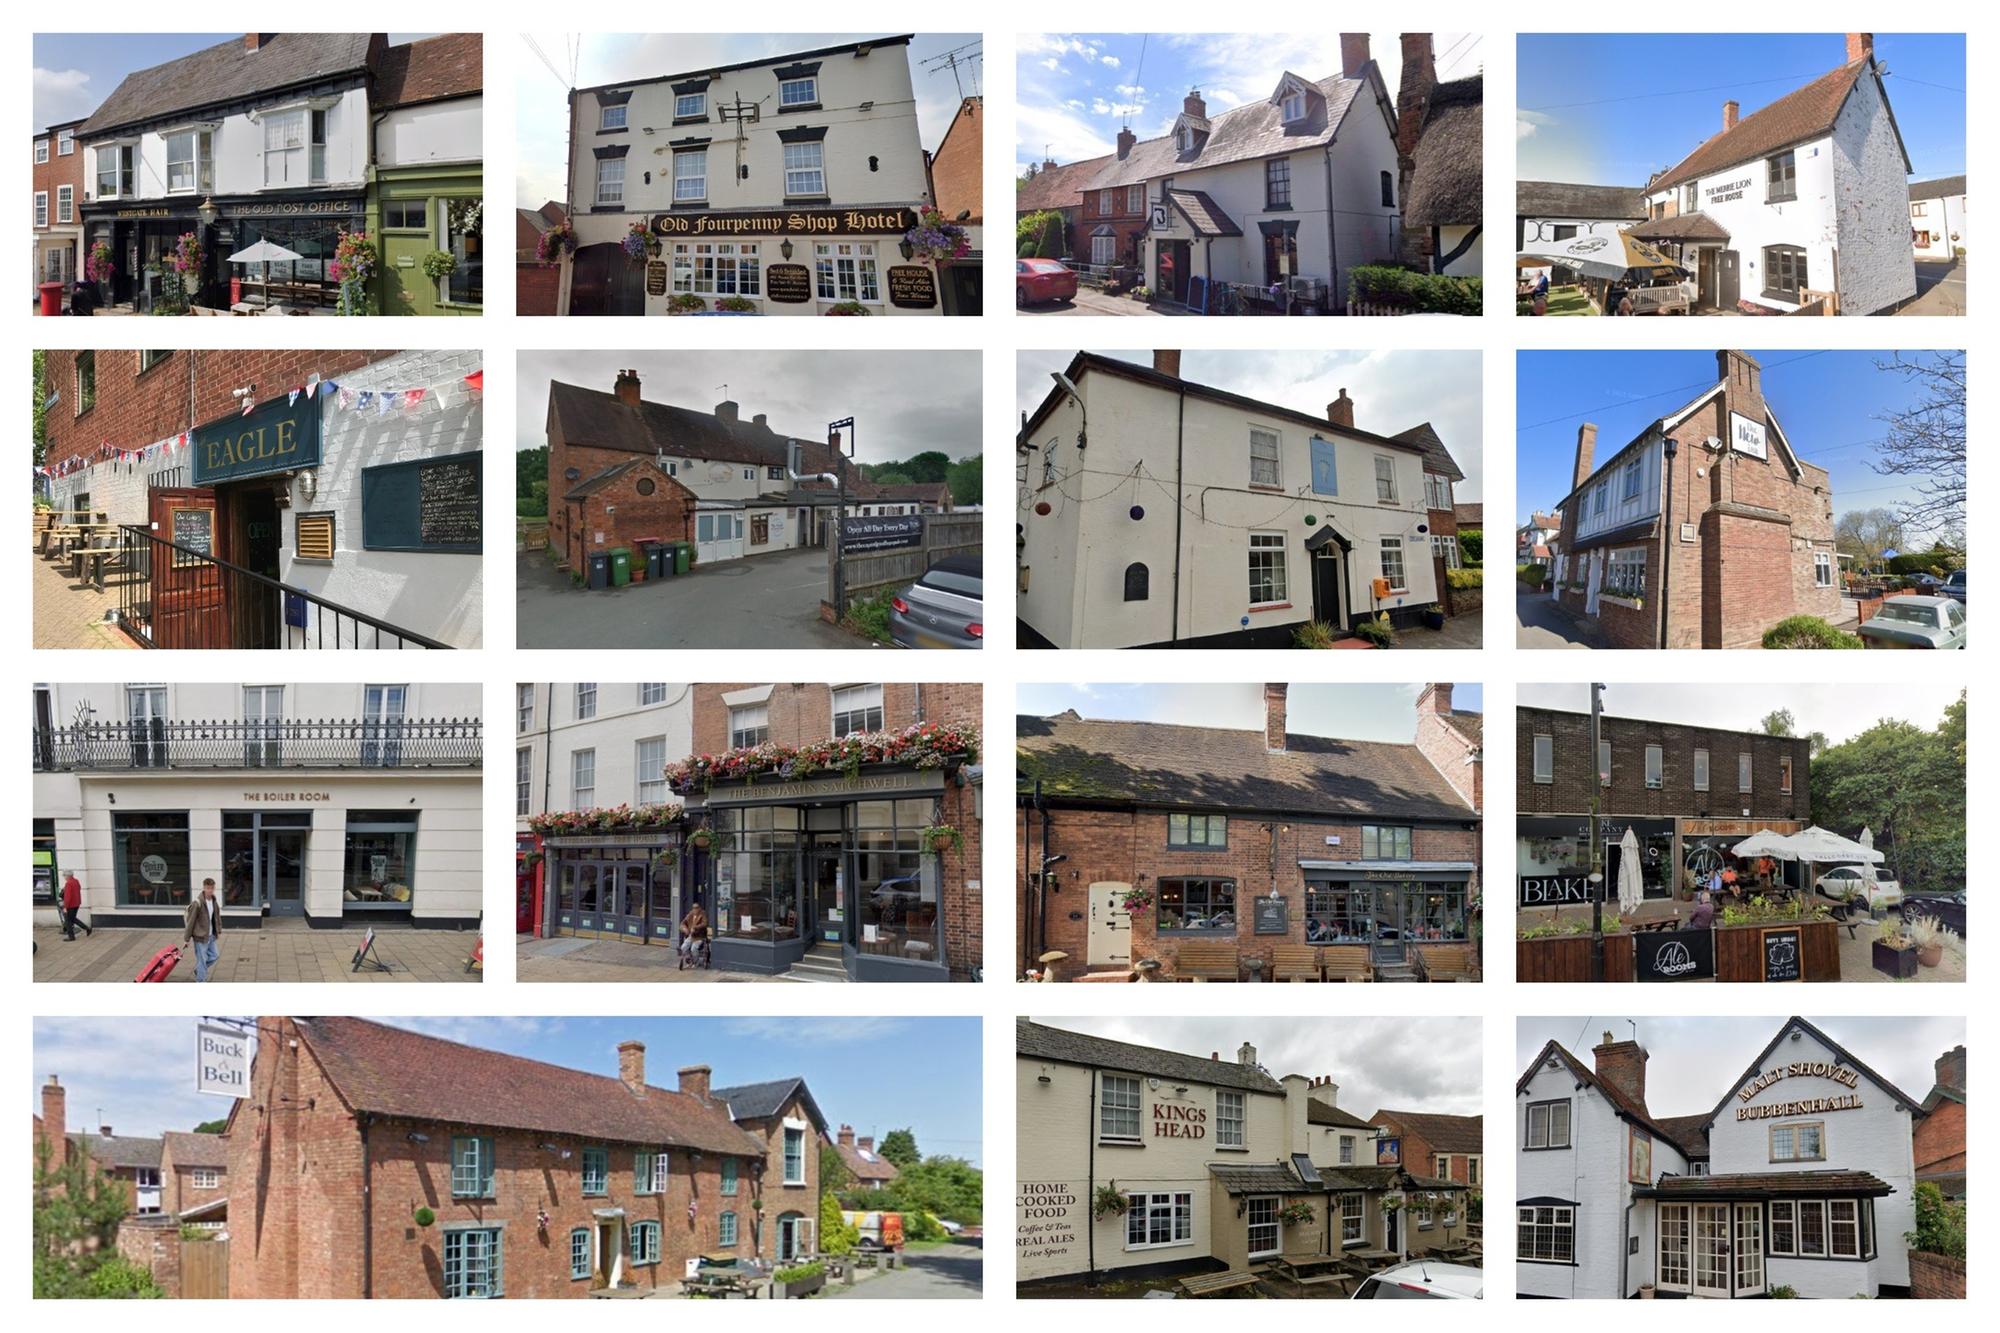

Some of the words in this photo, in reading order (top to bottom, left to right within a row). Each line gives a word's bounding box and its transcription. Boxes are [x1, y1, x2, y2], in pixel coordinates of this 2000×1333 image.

[1736, 178, 1752, 190] LION
[232, 206, 250, 214] THE
[253, 204, 274, 213] OLD
[277, 203, 305, 213] POST
[308, 201, 351, 212] OFFICE
[660, 217, 689, 233] Old
[692, 216, 783, 235] Fourpenny
[787, 213, 838, 233] Shop
[844, 211, 905, 231] Hotel
[913, 284, 933, 292] FOOD
[207, 419, 297, 469] EAGLE
[847, 526, 862, 534] Open
[864, 525, 872, 533] All
[883, 523, 899, 532] Every
[899, 523, 909, 531] Day
[728, 791, 749, 800] THE
[752, 785, 816, 799] BENJAMIN
[821, 776, 912, 793] SATCHWELL
[243, 792, 260, 801] THE
[264, 792, 296, 801] BOILER
[299, 792, 330, 801] ROOM
[1653, 942, 1686, 970] Ale
[1662, 961, 1697, 973] ROOMS
[203, 1037, 244, 1057] Buck
[204, 1066, 243, 1085] Bell
[1738, 1068, 1782, 1103] MALT
[1788, 1062, 1859, 1089] SHOVEL
[1153, 1103, 1207, 1123] KINGS
[1736, 1094, 1863, 1121] BUBBENHALL
[1154, 1121, 1205, 1139] HEAD
[1023, 1183, 1068, 1194] HOME
[1016, 1195, 1076, 1207] COOKED
[1024, 1207, 1067, 1219] FOOD
[1018, 1224, 1043, 1235] Coffee
[1045, 1223, 1054, 1231] &
[1055, 1222, 1071, 1230] Teas
[1016, 1236, 1045, 1247] REAL
[1047, 1234, 1075, 1244] ALES
[1022, 1250, 1042, 1258] Live
[1043, 1247, 1068, 1258] Sports
